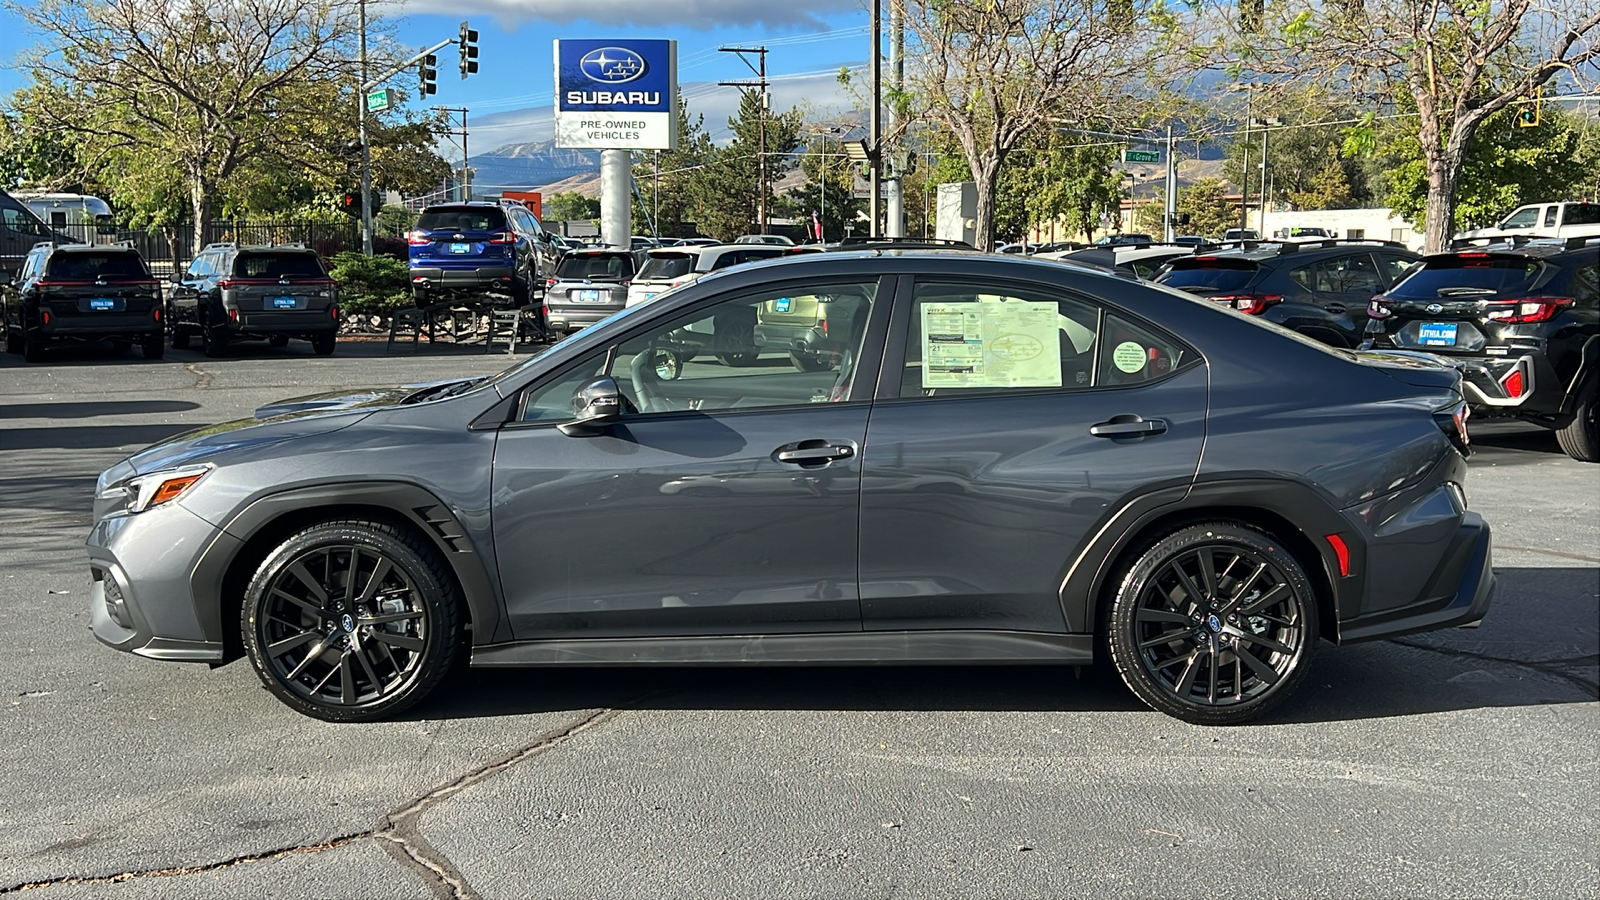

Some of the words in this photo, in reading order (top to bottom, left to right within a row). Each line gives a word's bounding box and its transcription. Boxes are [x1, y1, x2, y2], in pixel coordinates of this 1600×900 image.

[567, 91, 660, 105] SUBARU
[580, 120, 646, 129] PRE-OWNED
[586, 131, 640, 140] VEHICLES
[1420, 329, 1457, 339] LITHIA.COM
